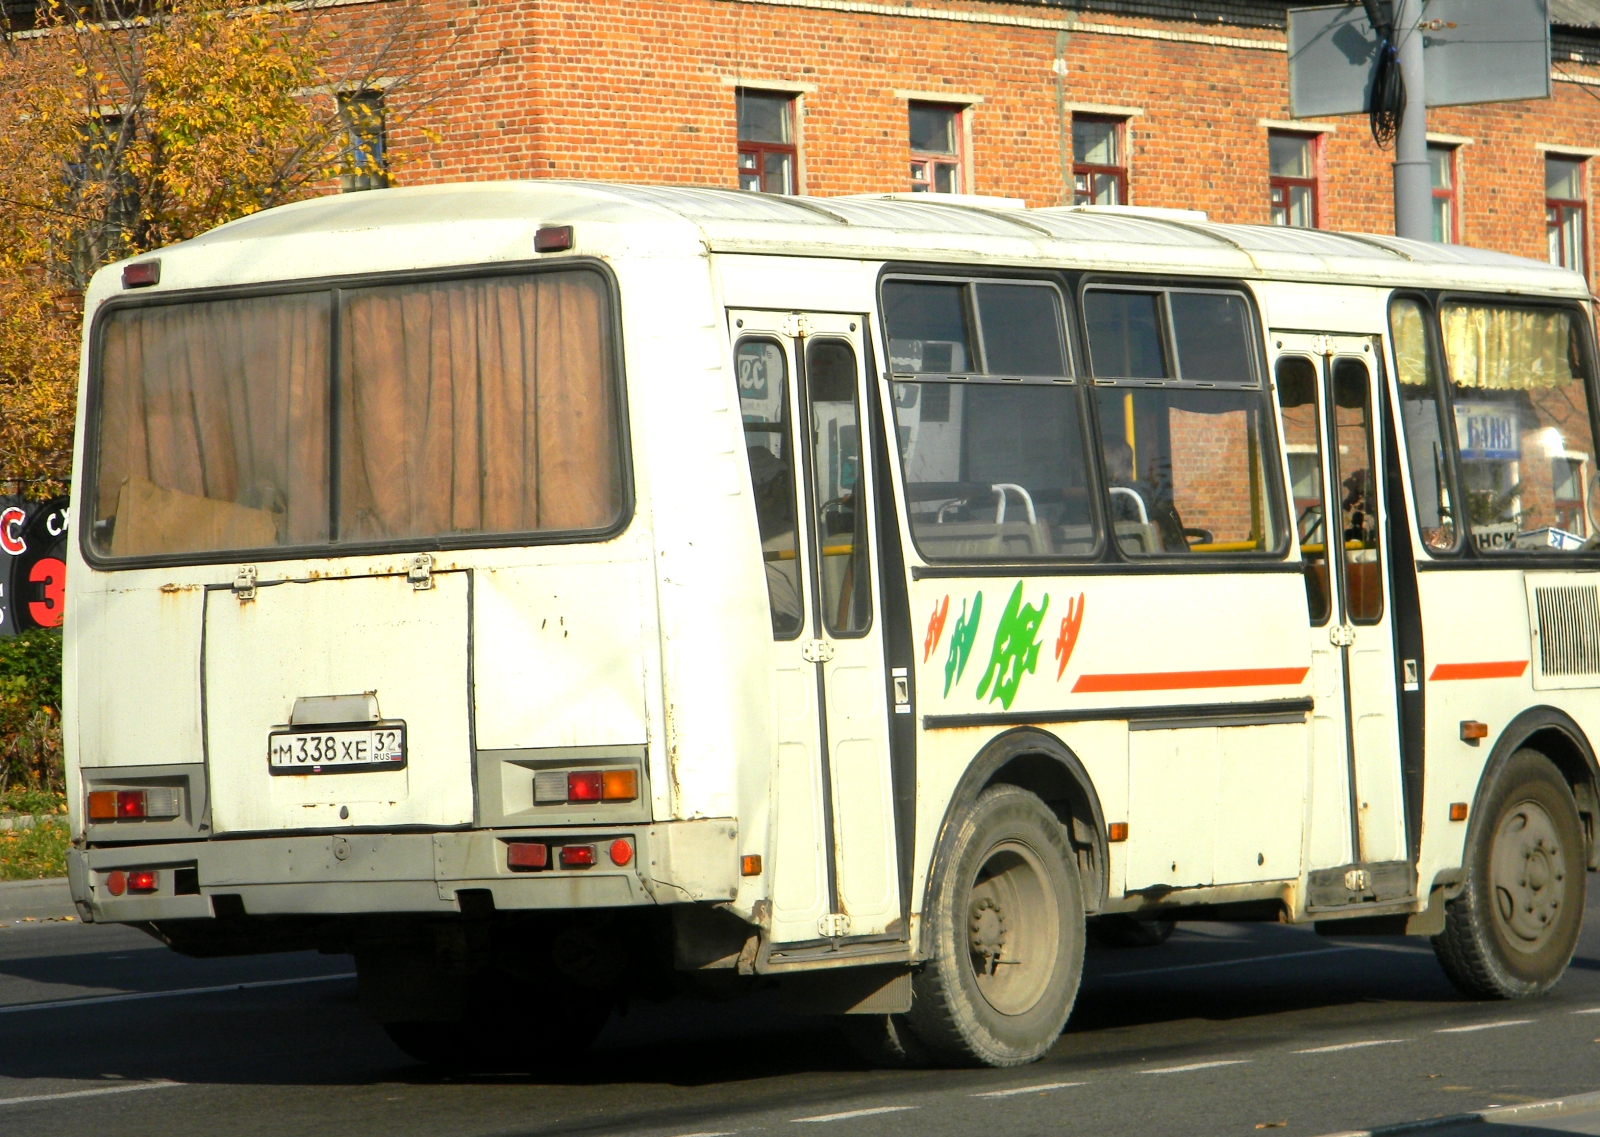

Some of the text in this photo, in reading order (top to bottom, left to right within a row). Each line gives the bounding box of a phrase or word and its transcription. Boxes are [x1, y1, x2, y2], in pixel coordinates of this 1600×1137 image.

[1473, 531, 1515, 549] НСК
[279, 732, 396, 764] М338ХЕ 32
[373, 752, 390, 761] RUS
